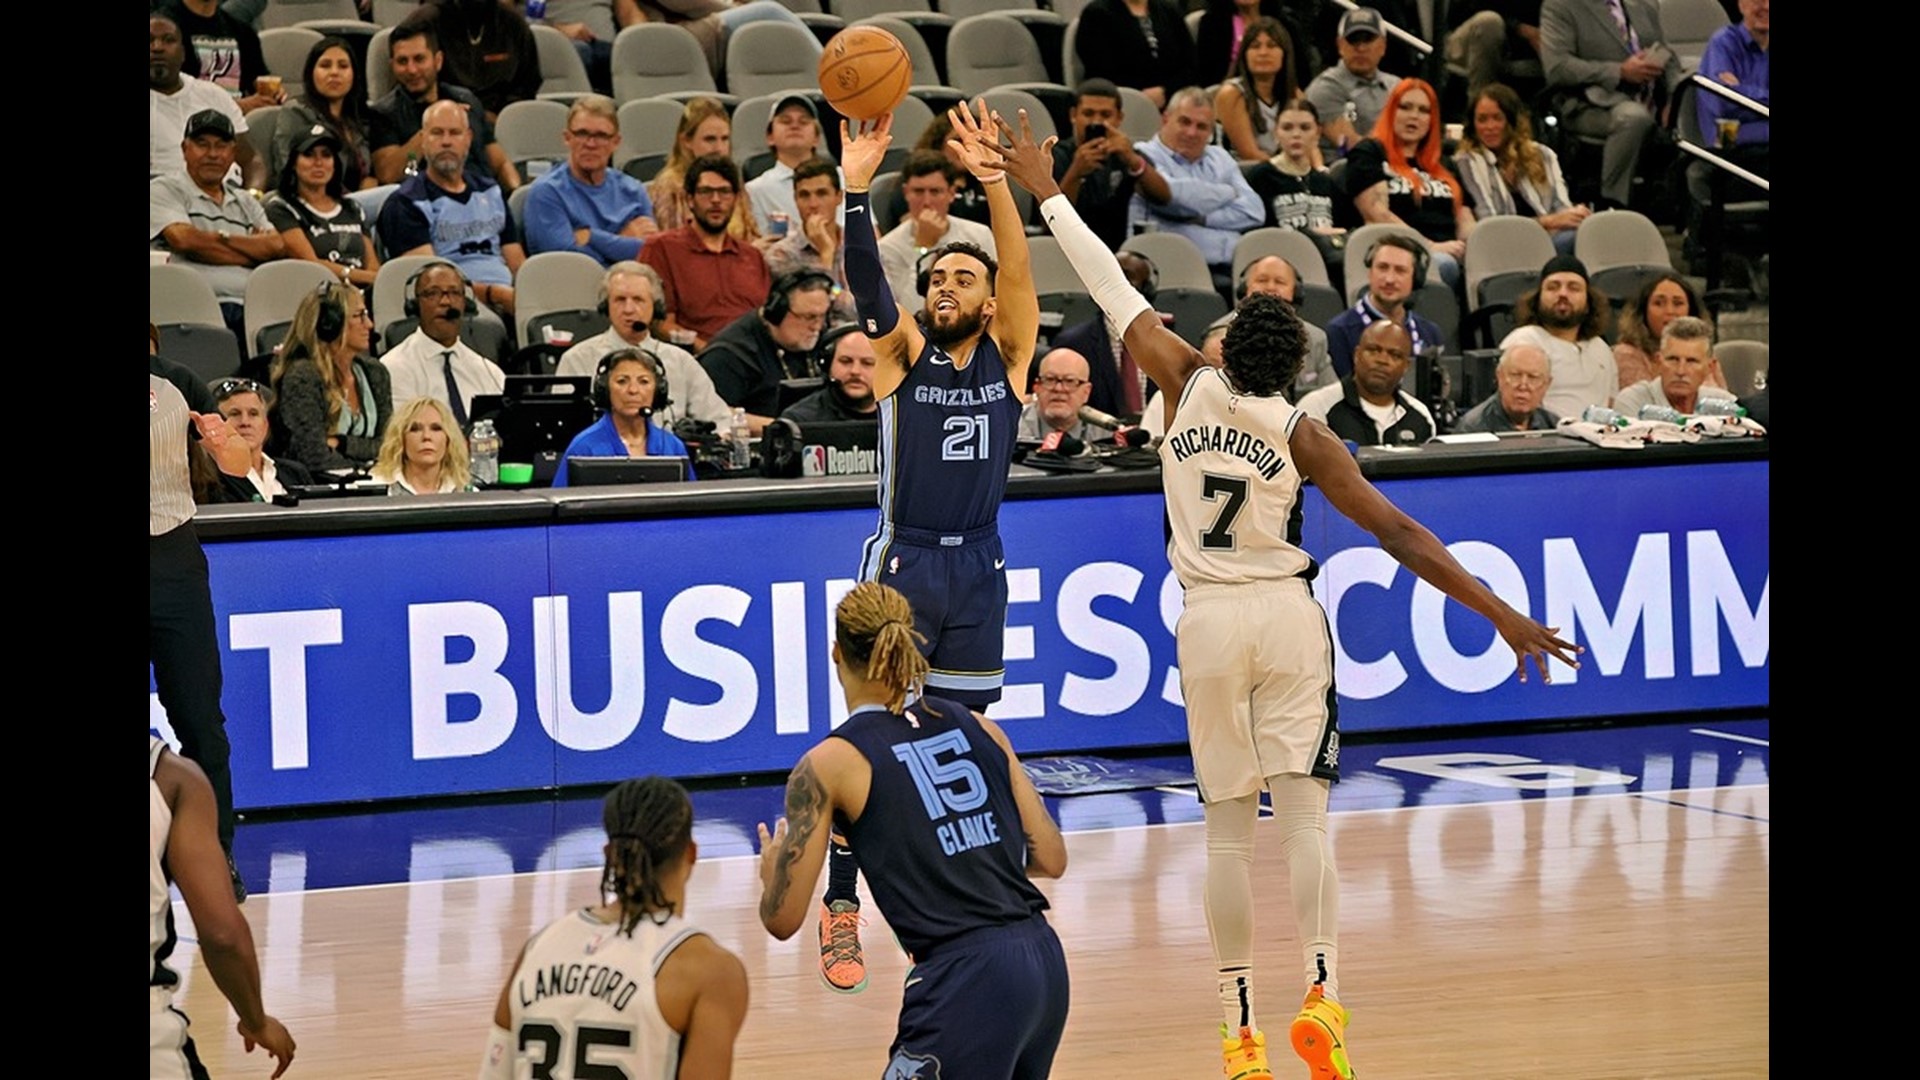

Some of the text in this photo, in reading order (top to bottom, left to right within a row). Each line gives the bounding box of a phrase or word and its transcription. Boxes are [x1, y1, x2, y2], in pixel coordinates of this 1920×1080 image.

[914, 380, 1007, 407] GRIZZLIES
[827, 445, 876, 475] Replay
[942, 414, 990, 461] 21
[1170, 426, 1286, 481] RICHARDSON
[1198, 470, 1250, 552] 7
[407, 560, 1186, 760] BUSIES
[891, 728, 988, 821] 15
[519, 963, 638, 1012] LANGFORD
[517, 1020, 637, 1080] 35
